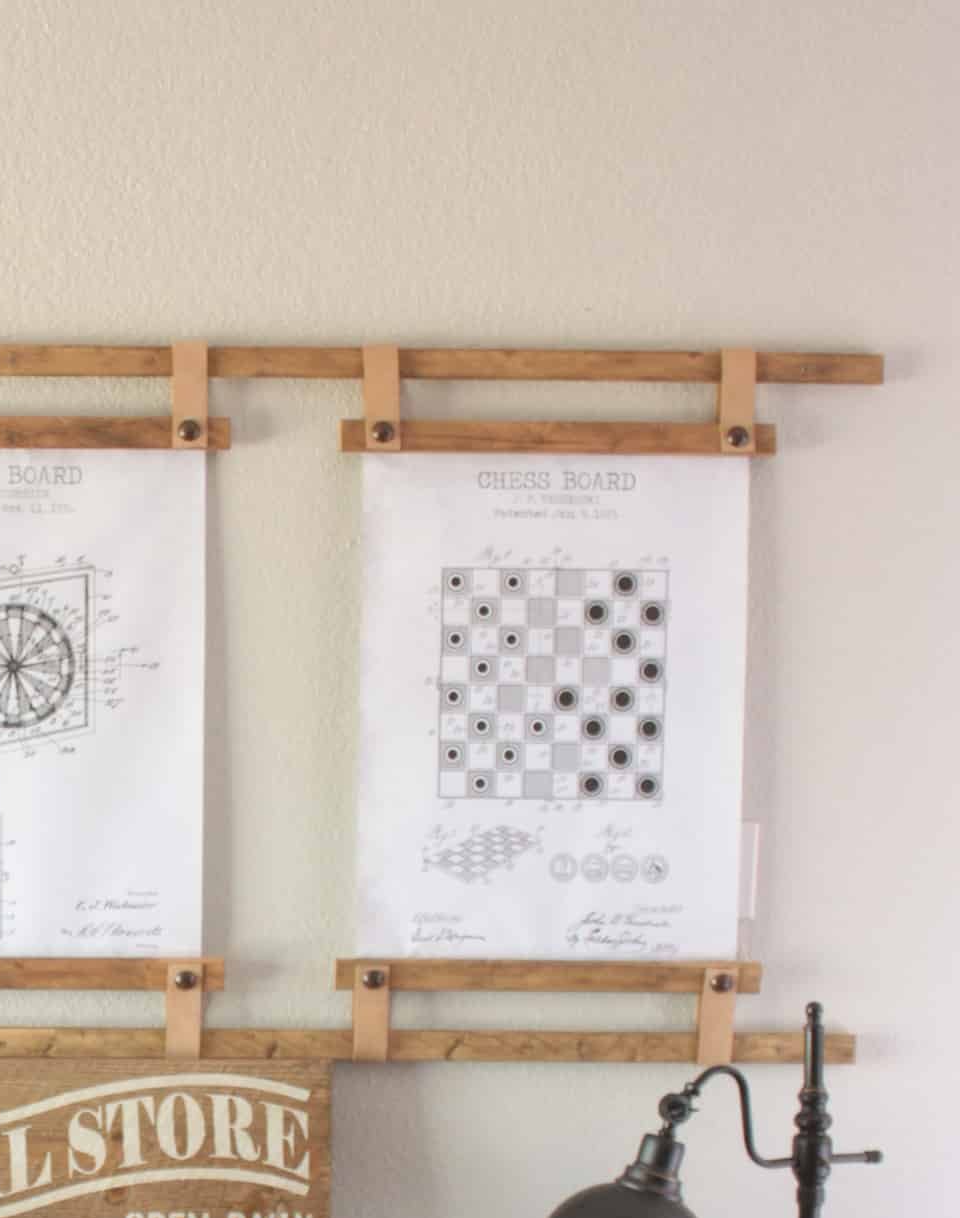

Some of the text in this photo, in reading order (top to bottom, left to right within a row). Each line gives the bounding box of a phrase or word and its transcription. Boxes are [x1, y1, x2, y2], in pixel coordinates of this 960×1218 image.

[7, 464, 83, 485] BOARD
[477, 471, 638, 491] CHESS BOARD
[67, 1091, 311, 1181] STORE
